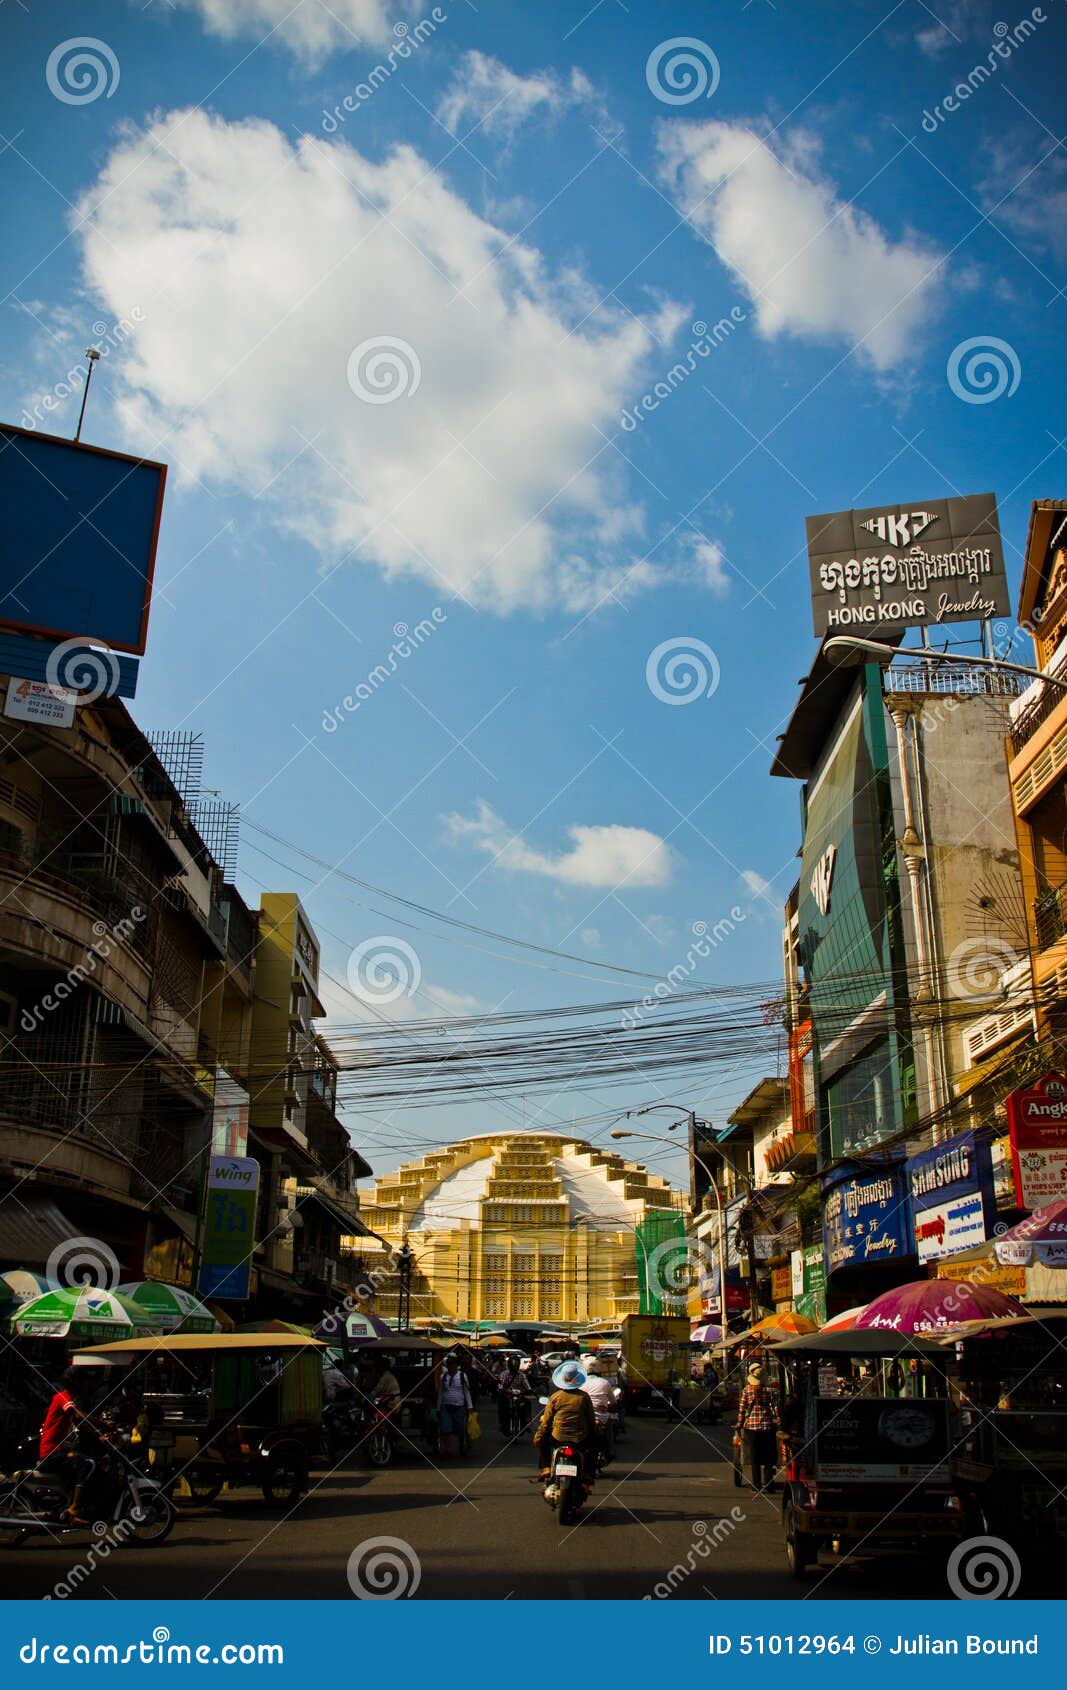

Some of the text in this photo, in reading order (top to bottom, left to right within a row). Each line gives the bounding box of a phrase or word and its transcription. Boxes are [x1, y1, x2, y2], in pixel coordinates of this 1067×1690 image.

[828, 591, 996, 626] HONG KONG Jewelry
[215, 1167, 252, 1185] Wing
[911, 1145, 971, 1197] SAMSUNG
